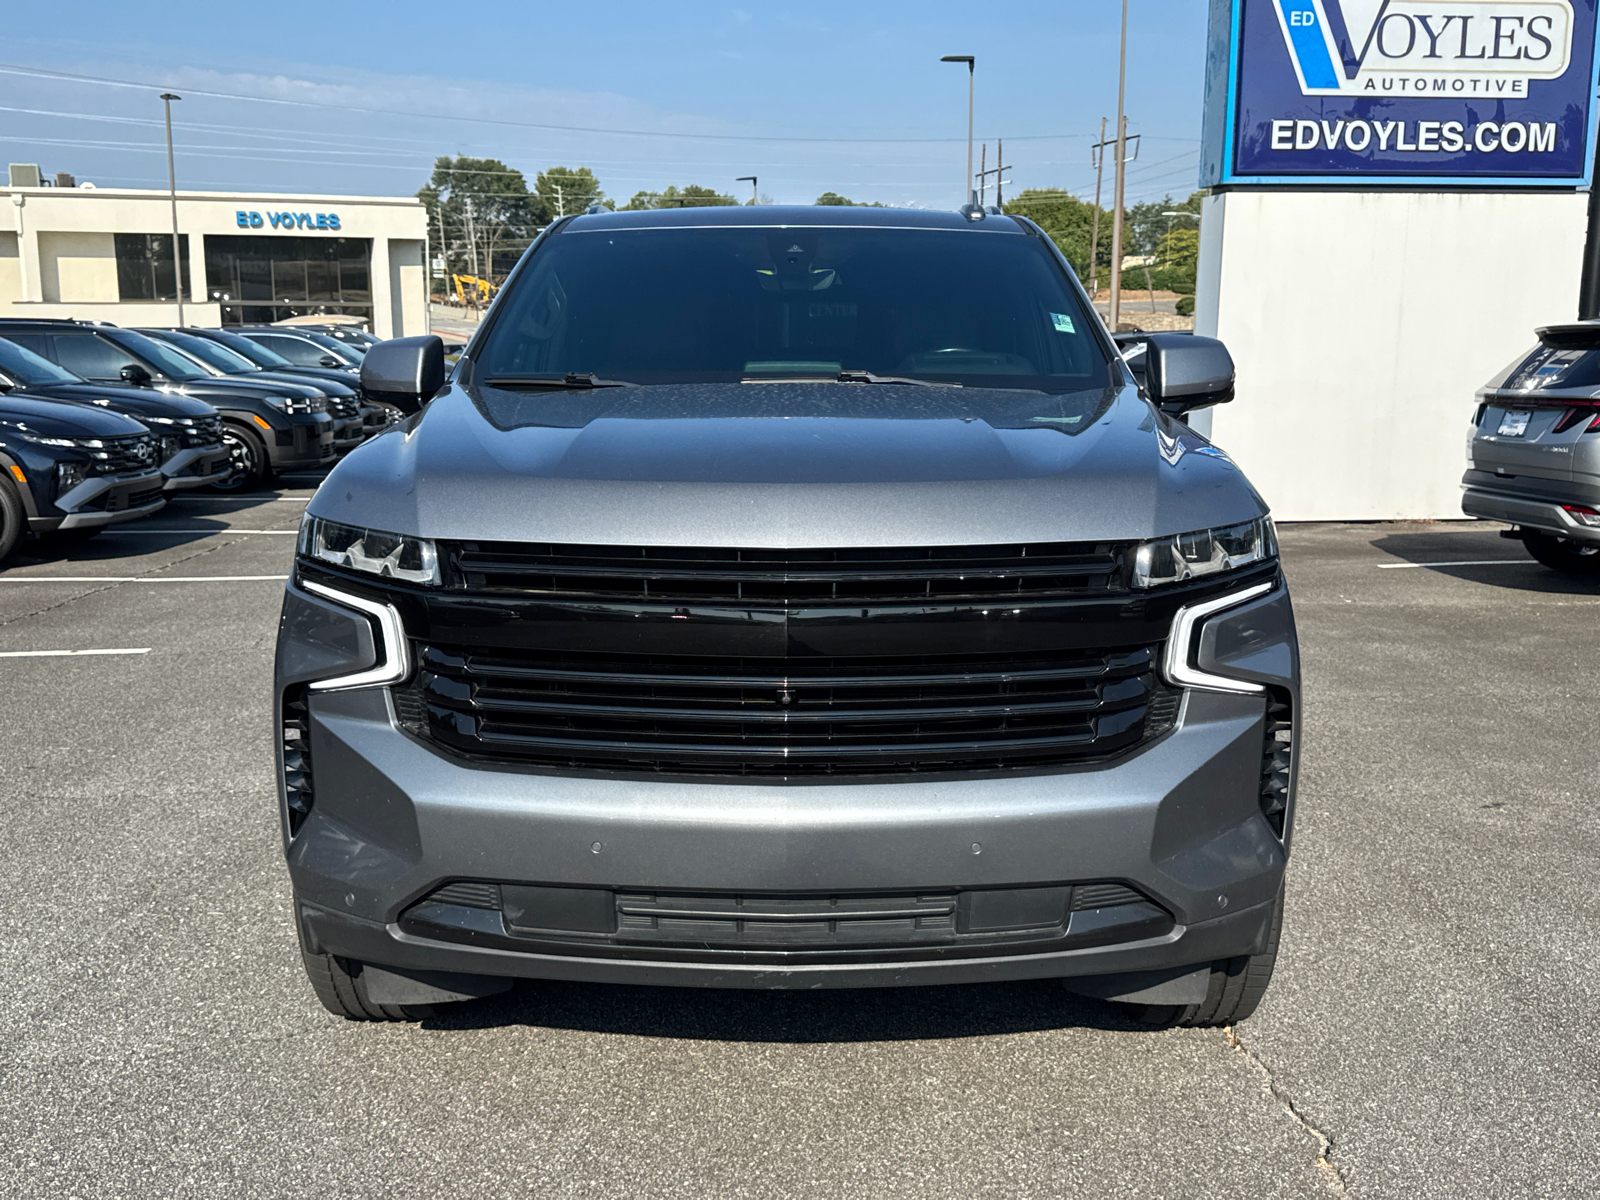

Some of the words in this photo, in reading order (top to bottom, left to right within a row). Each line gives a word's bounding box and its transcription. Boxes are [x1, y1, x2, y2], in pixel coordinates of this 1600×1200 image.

[1290, 11, 1315, 26] ED
[1320, 0, 1552, 79] VOYLES
[1364, 78, 1523, 92] AUTOMOTIVE
[1270, 119, 1556, 152] EDVOYLES.COM
[236, 211, 264, 229] ED
[266, 211, 342, 231] VOYLES
